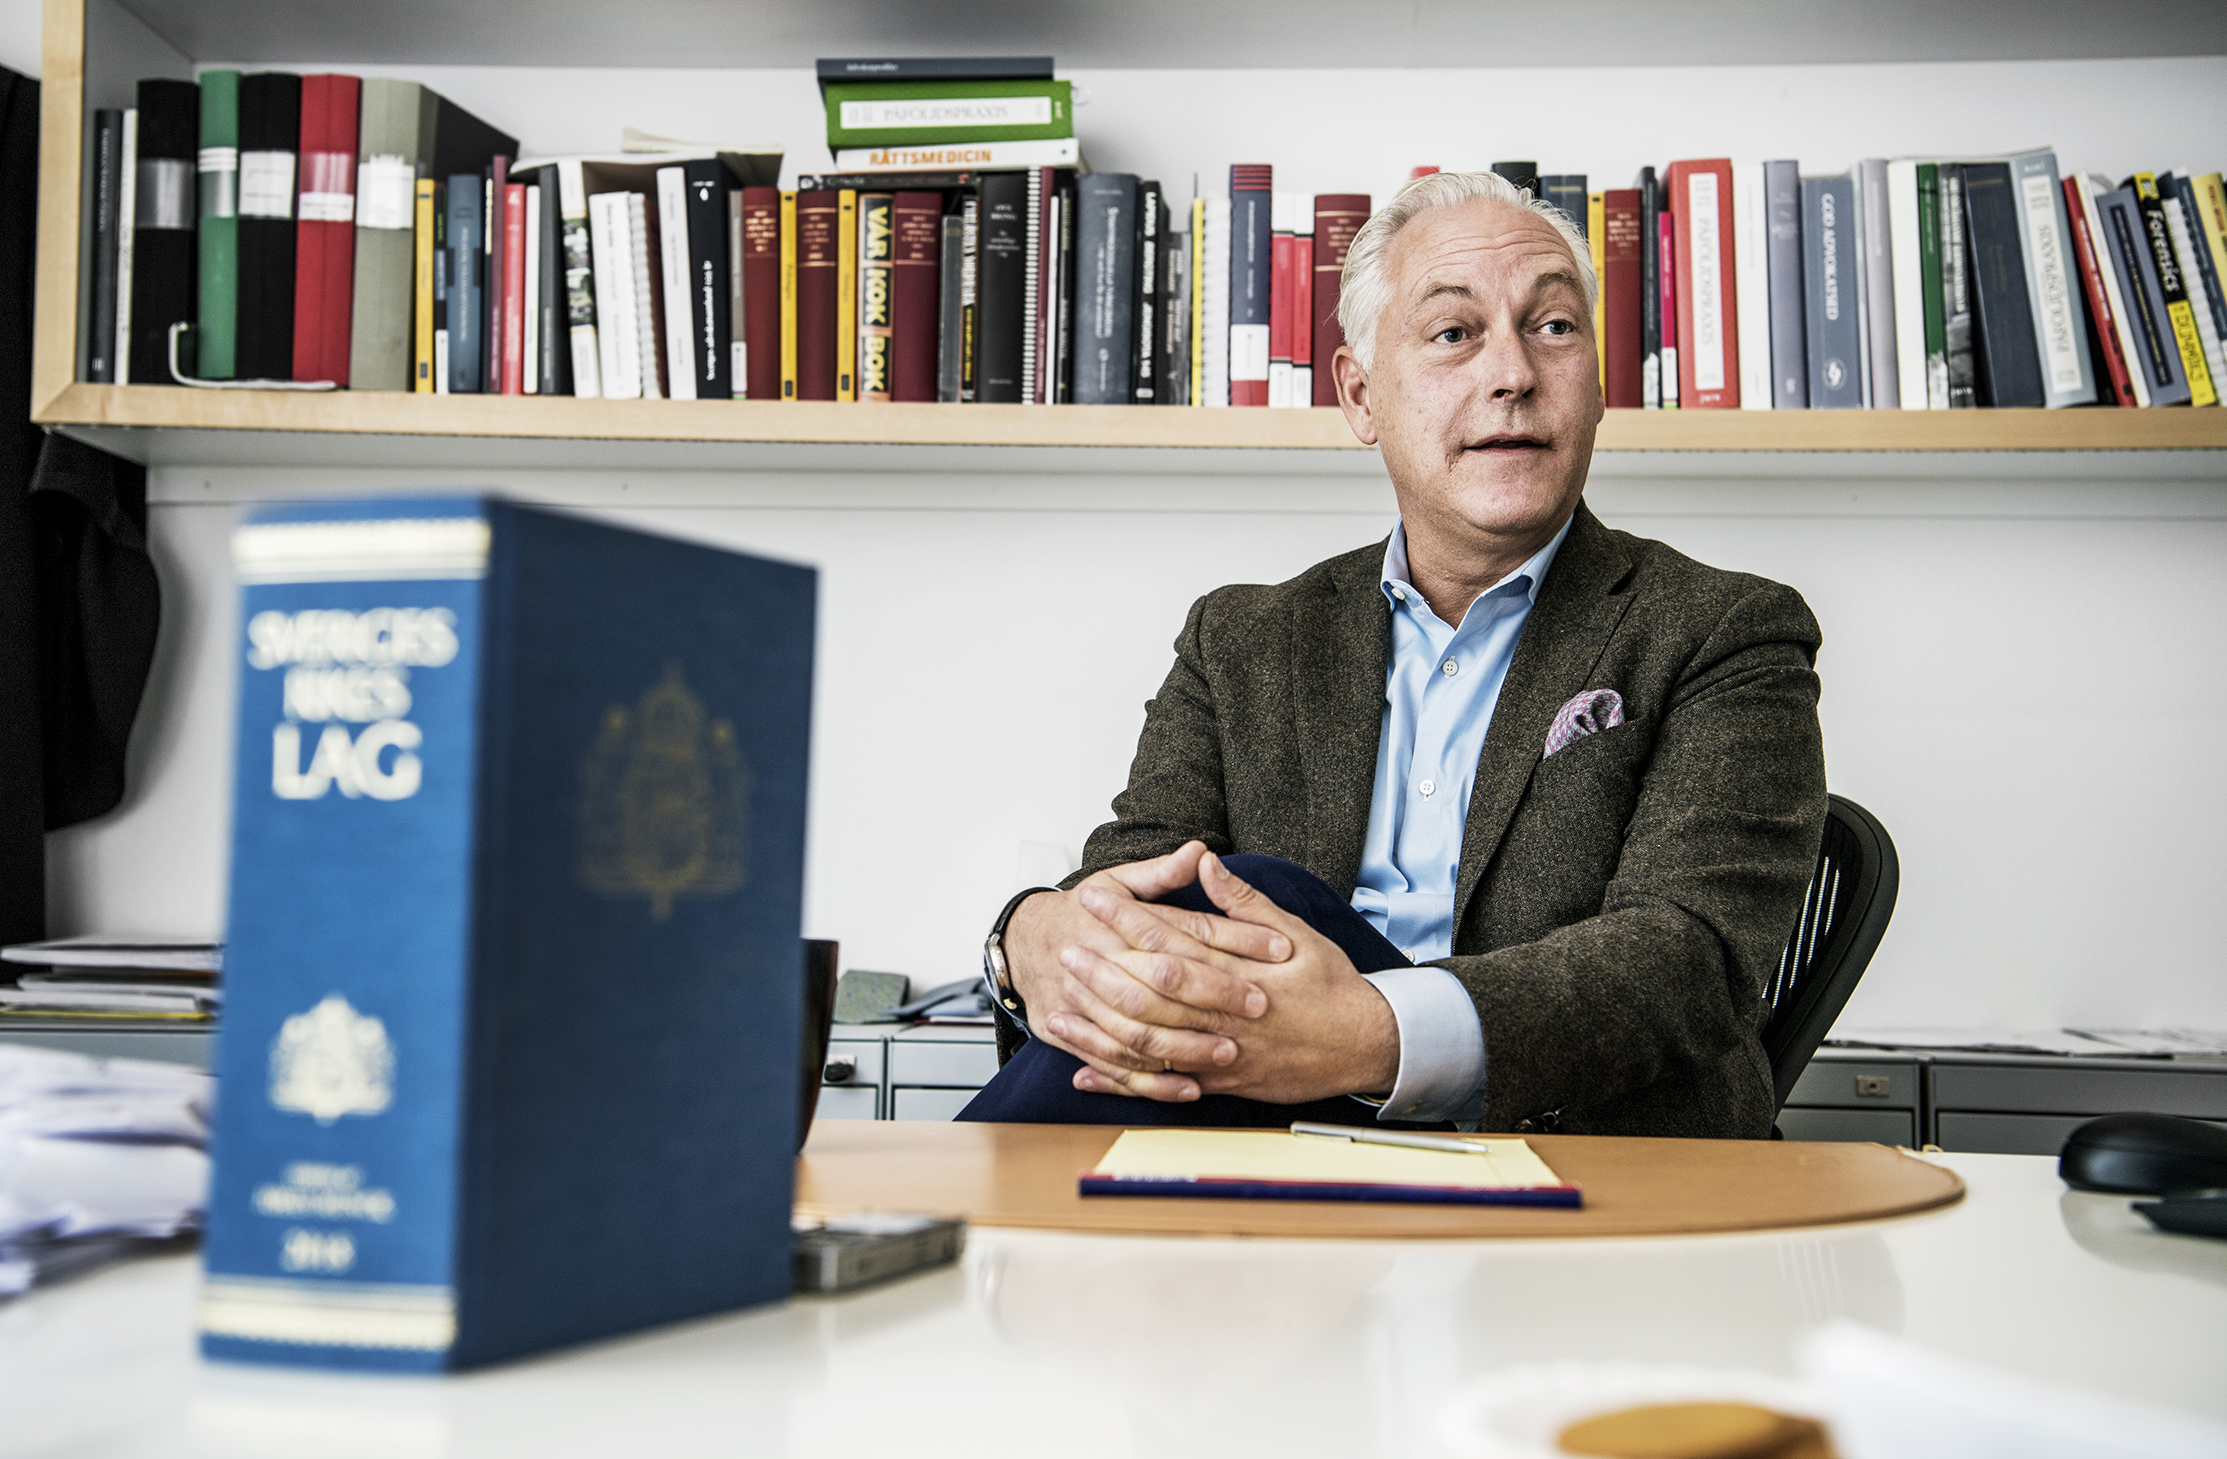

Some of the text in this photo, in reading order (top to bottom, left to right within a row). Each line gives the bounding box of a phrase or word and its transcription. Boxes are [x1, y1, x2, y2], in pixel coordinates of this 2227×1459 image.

[869, 148, 993, 166] RÄTTSMEDICIN
[1820, 192, 1840, 321] GOD ADVOKATSED
[2146, 208, 2181, 293] Forensics
[864, 206, 893, 392] VÅR KOK BOK
[272, 719, 423, 801] LAG
